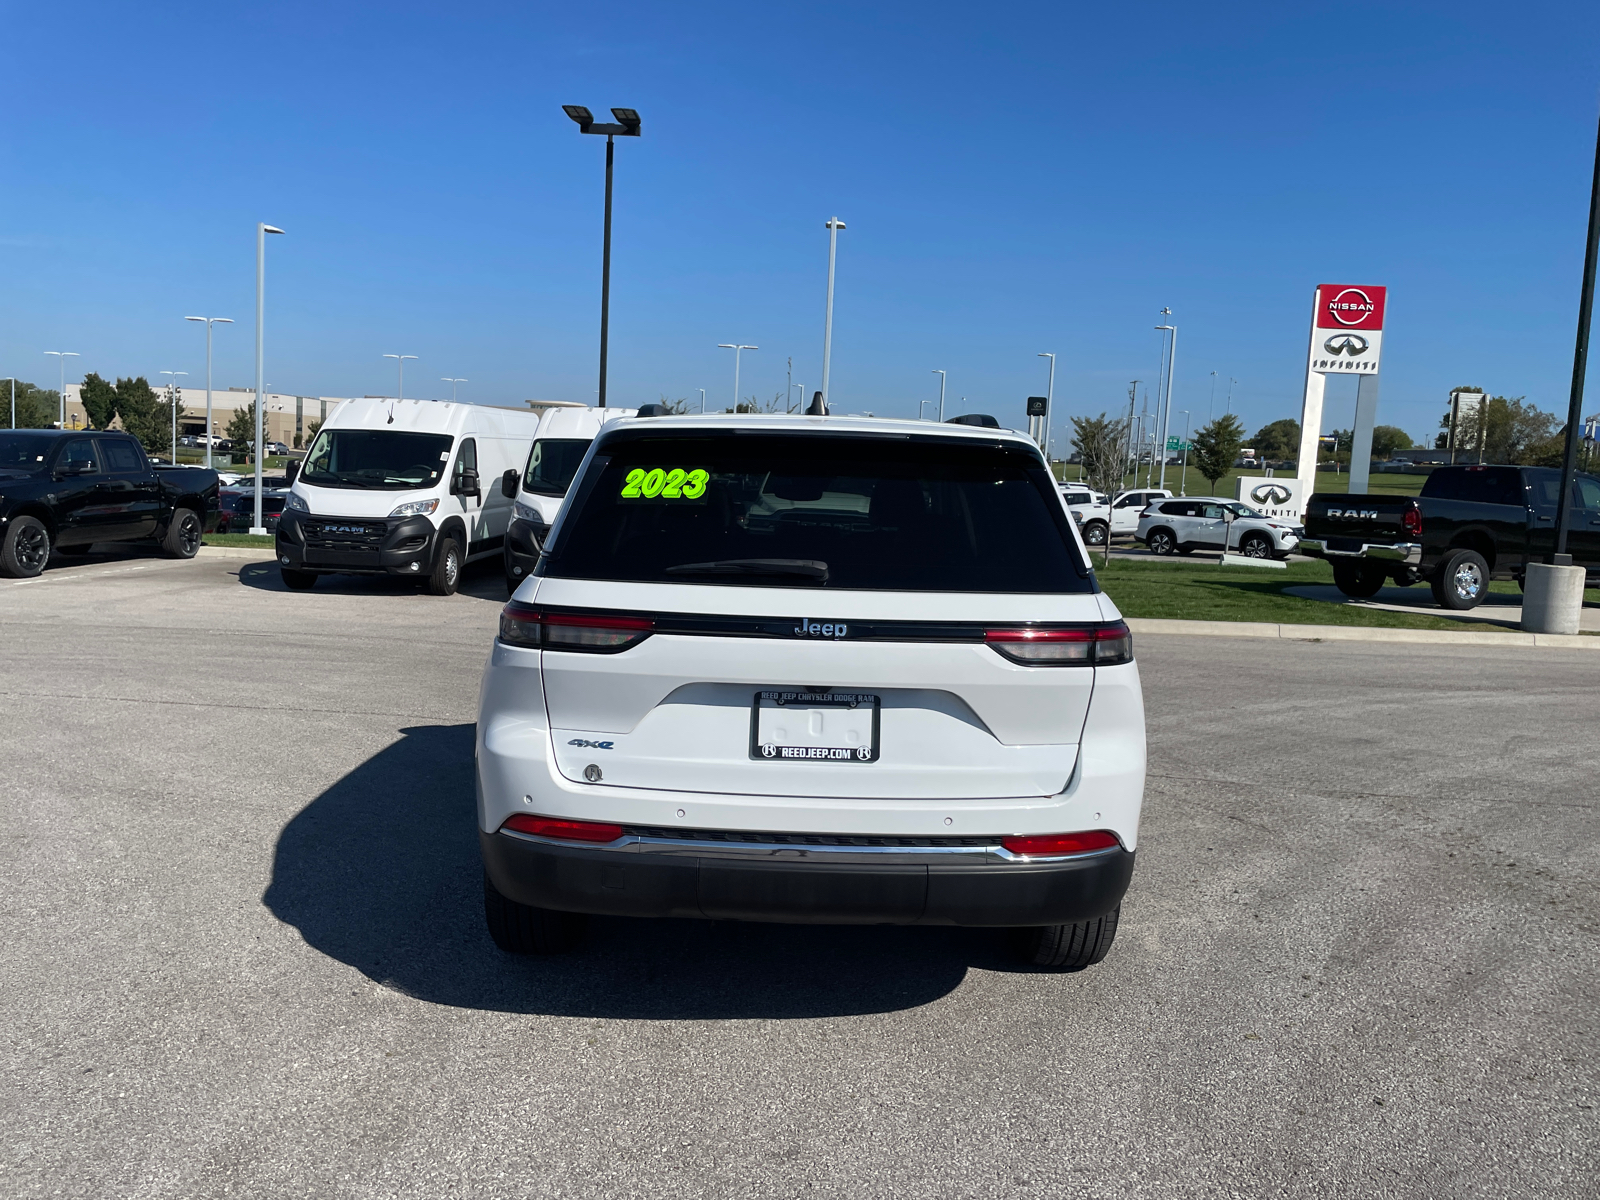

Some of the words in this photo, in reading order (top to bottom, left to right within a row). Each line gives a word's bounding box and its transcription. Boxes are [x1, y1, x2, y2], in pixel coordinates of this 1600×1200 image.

[1329, 302, 1374, 311] NISSAN
[1313, 359, 1377, 371] INFINITI
[621, 468, 710, 499] 2023
[1253, 508, 1297, 517] FINITI
[1327, 508, 1378, 519] RAM
[324, 525, 364, 533] RAM
[794, 618, 847, 641] Jeep
[761, 691, 779, 700] REED
[780, 692, 797, 701] JEEP
[798, 693, 833, 702] CHRYSLER
[834, 694, 857, 702] DODGE
[858, 695, 875, 703] RAM
[781, 747, 851, 760] REEDJEEP.COM
